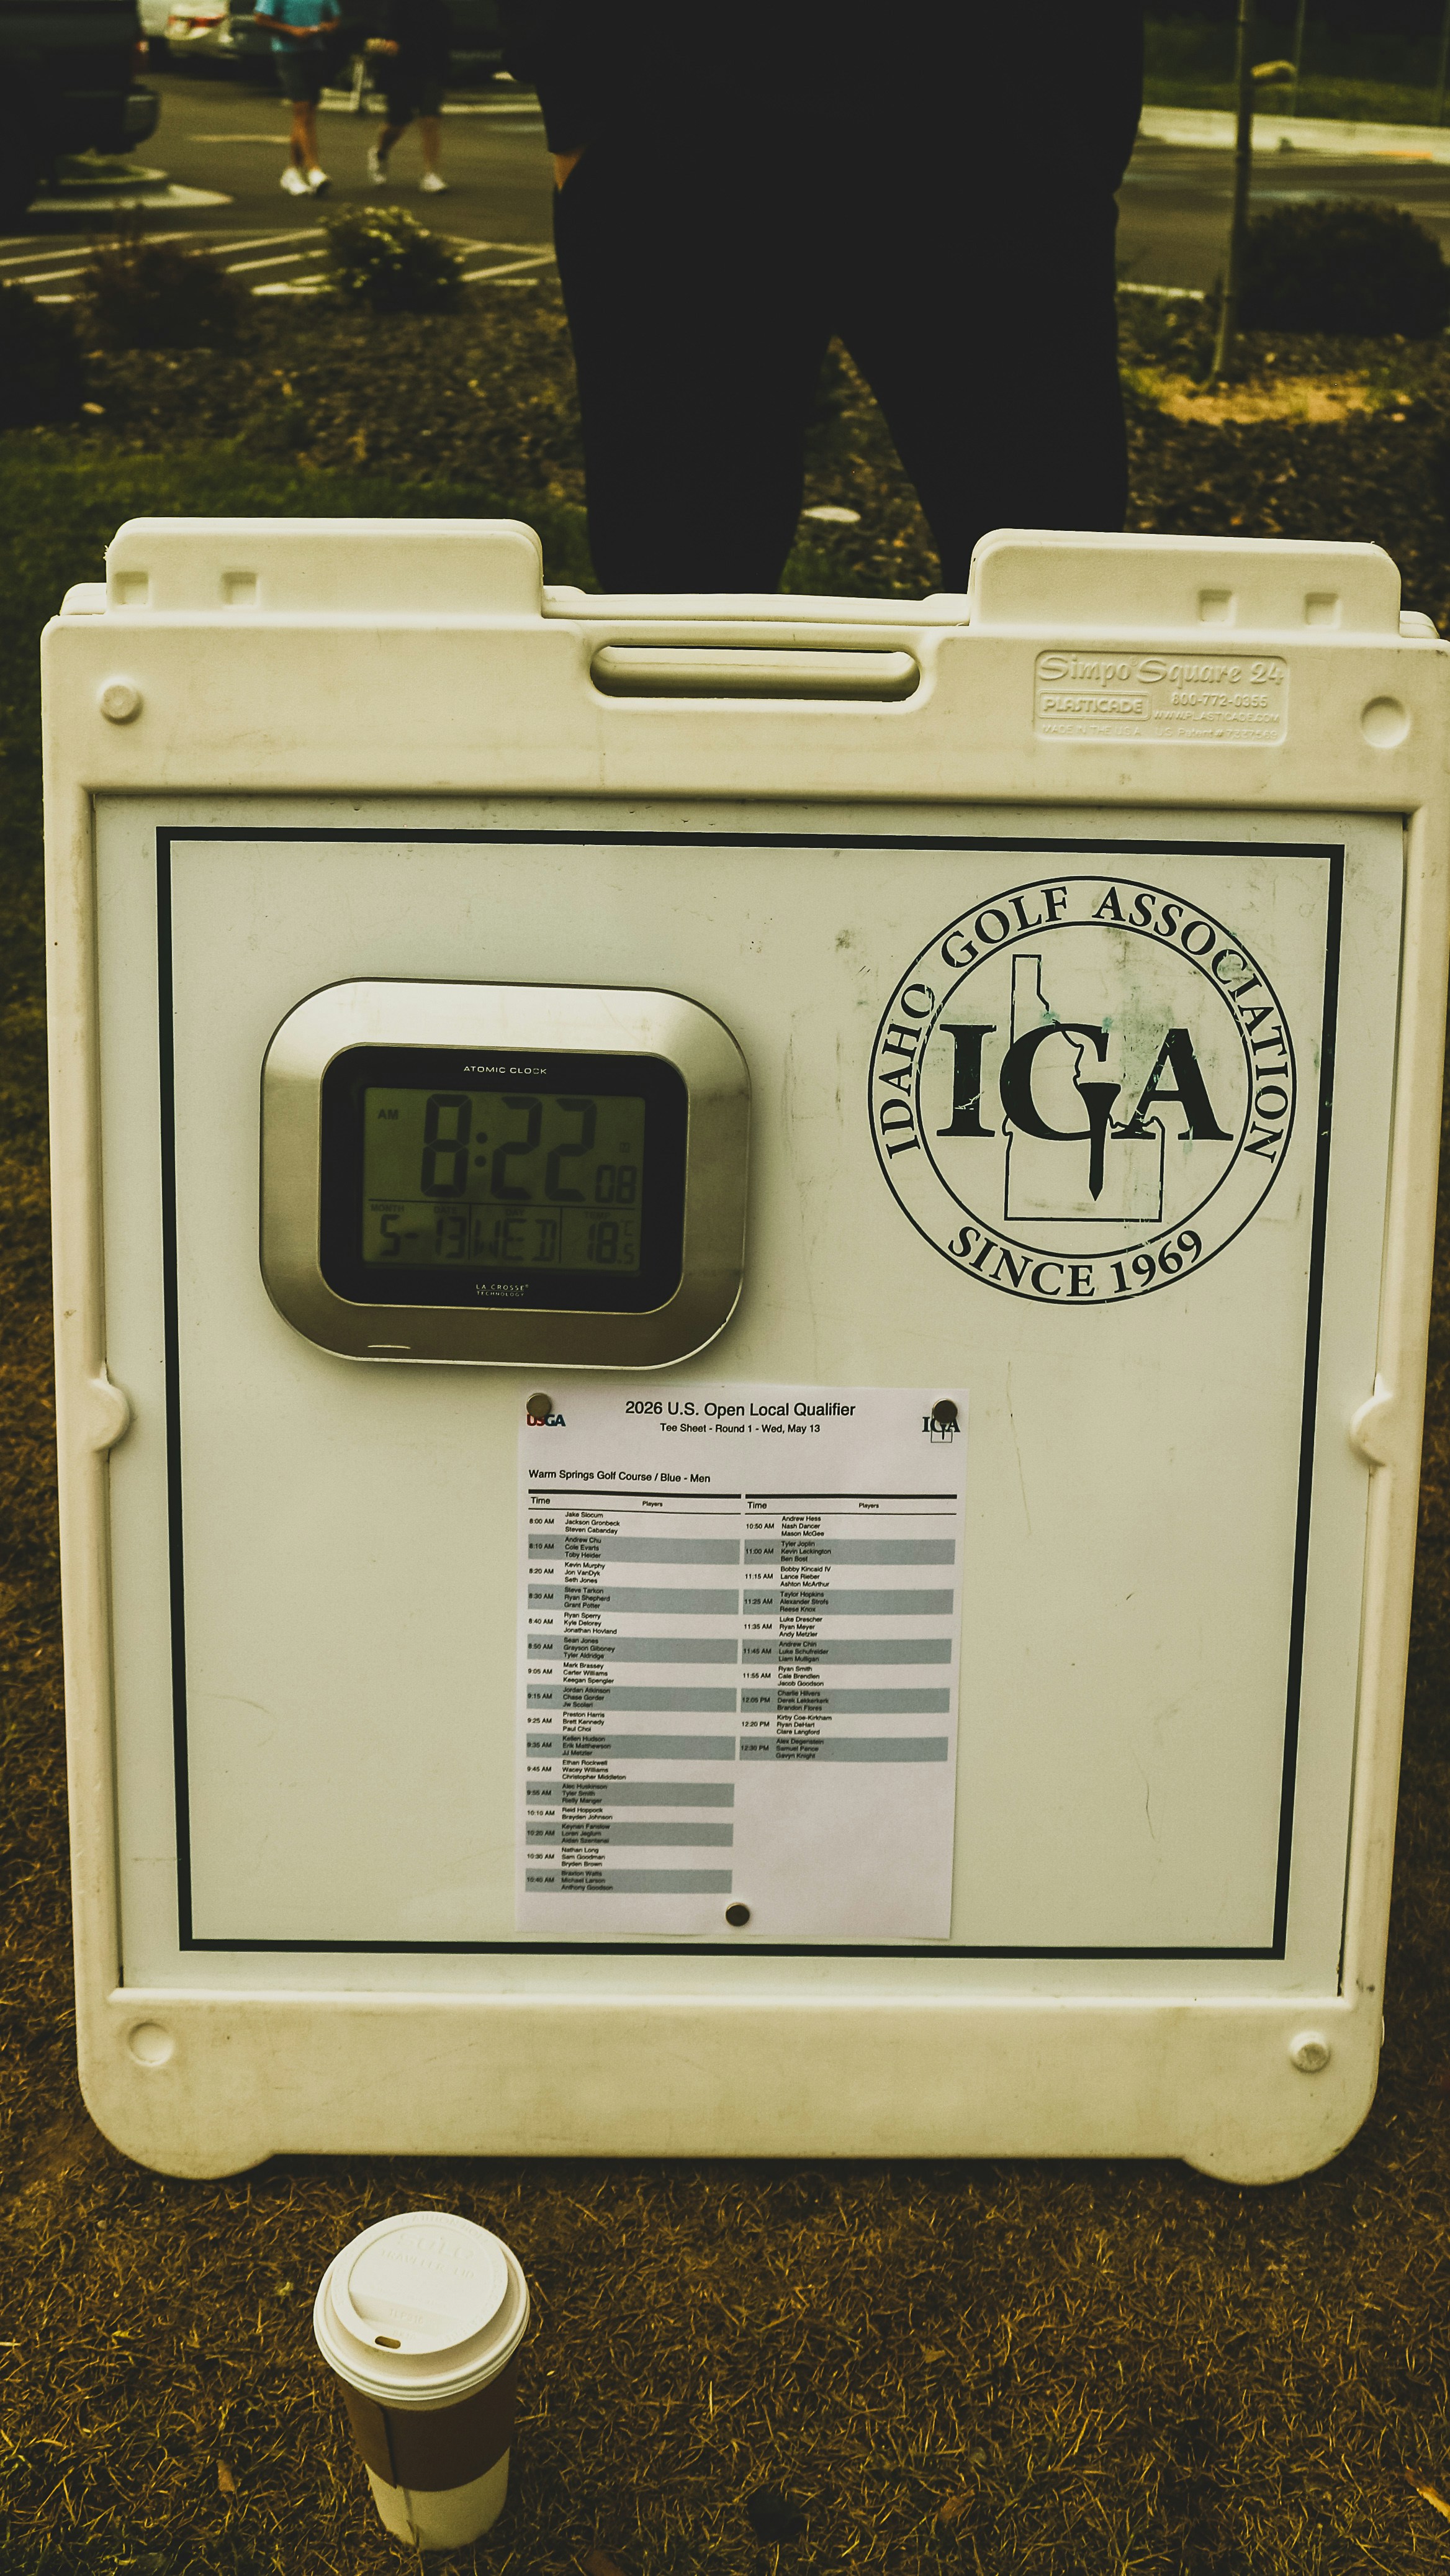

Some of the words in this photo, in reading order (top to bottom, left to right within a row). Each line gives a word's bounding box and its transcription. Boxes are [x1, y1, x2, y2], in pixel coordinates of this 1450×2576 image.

[1137, 658, 1242, 689] Square
[1250, 662, 1284, 685] 24
[1043, 697, 1143, 714] PLASTICADE
[1171, 693, 1268, 708] 800-772-0355
[878, 983, 935, 1159] IDAHO
[941, 885, 1068, 969] GOLF
[1092, 886, 1289, 1163] ASSOCIATION
[936, 1023, 1234, 1142] IGA
[377, 1109, 399, 1119] AM
[421, 1093, 597, 1203] 8:22
[595, 1164, 637, 1204] 08
[371, 1204, 404, 1213] MONTH
[505, 1208, 525, 1216] DAY
[474, 1218, 557, 1262] WED
[947, 1226, 1095, 1297] SINCE
[1110, 1229, 1202, 1294] 1969
[625, 1401, 663, 1414] 2026
[667, 1402, 699, 1416] U.S.
[704, 1403, 745, 1419] Open
[750, 1403, 789, 1416] Local
[794, 1403, 856, 1417] Qualifier
[660, 1422, 677, 1432] Tee
[680, 1423, 706, 1432] Sheet
[715, 1424, 744, 1433] Round
[748, 1424, 752, 1432] 1
[762, 1424, 785, 1435] Wed,
[787, 1424, 806, 1435] May
[809, 1424, 821, 1432] 13
[529, 1469, 556, 1478] Warm
[559, 1470, 594, 1481] Springs
[597, 1471, 616, 1480] Golf
[618, 1471, 652, 1481] Course
[660, 1473, 681, 1482] Blue
[690, 1473, 711, 1483] Men
